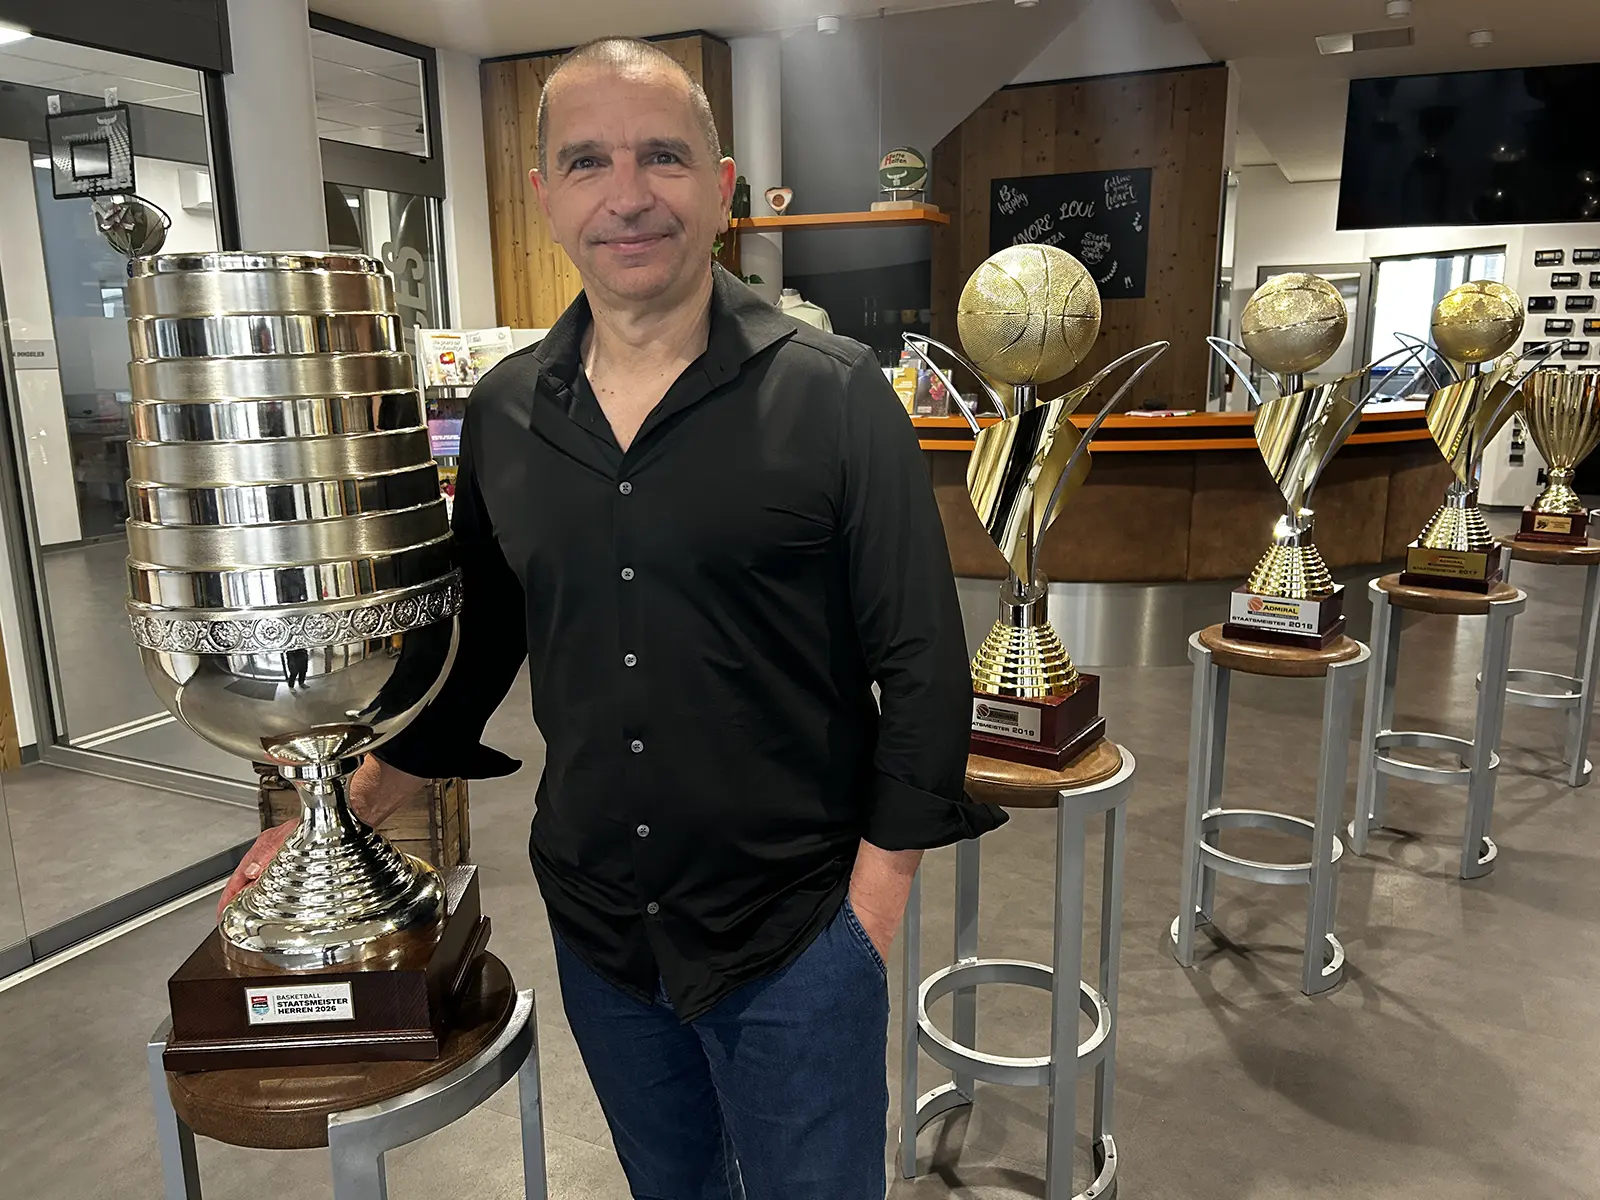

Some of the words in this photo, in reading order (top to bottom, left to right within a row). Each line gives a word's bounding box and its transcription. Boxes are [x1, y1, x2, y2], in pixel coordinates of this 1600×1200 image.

[1263, 605, 1298, 615] ADMIRAL
[1232, 616, 1286, 627] STAATSMEISTER
[1288, 621, 1313, 629] 2018
[972, 721, 1010, 732] ATSMEISTER
[1012, 727, 1035, 737] 2019
[277, 998, 348, 1007] STAATSMEISTER
[315, 1005, 337, 1013] 2026
